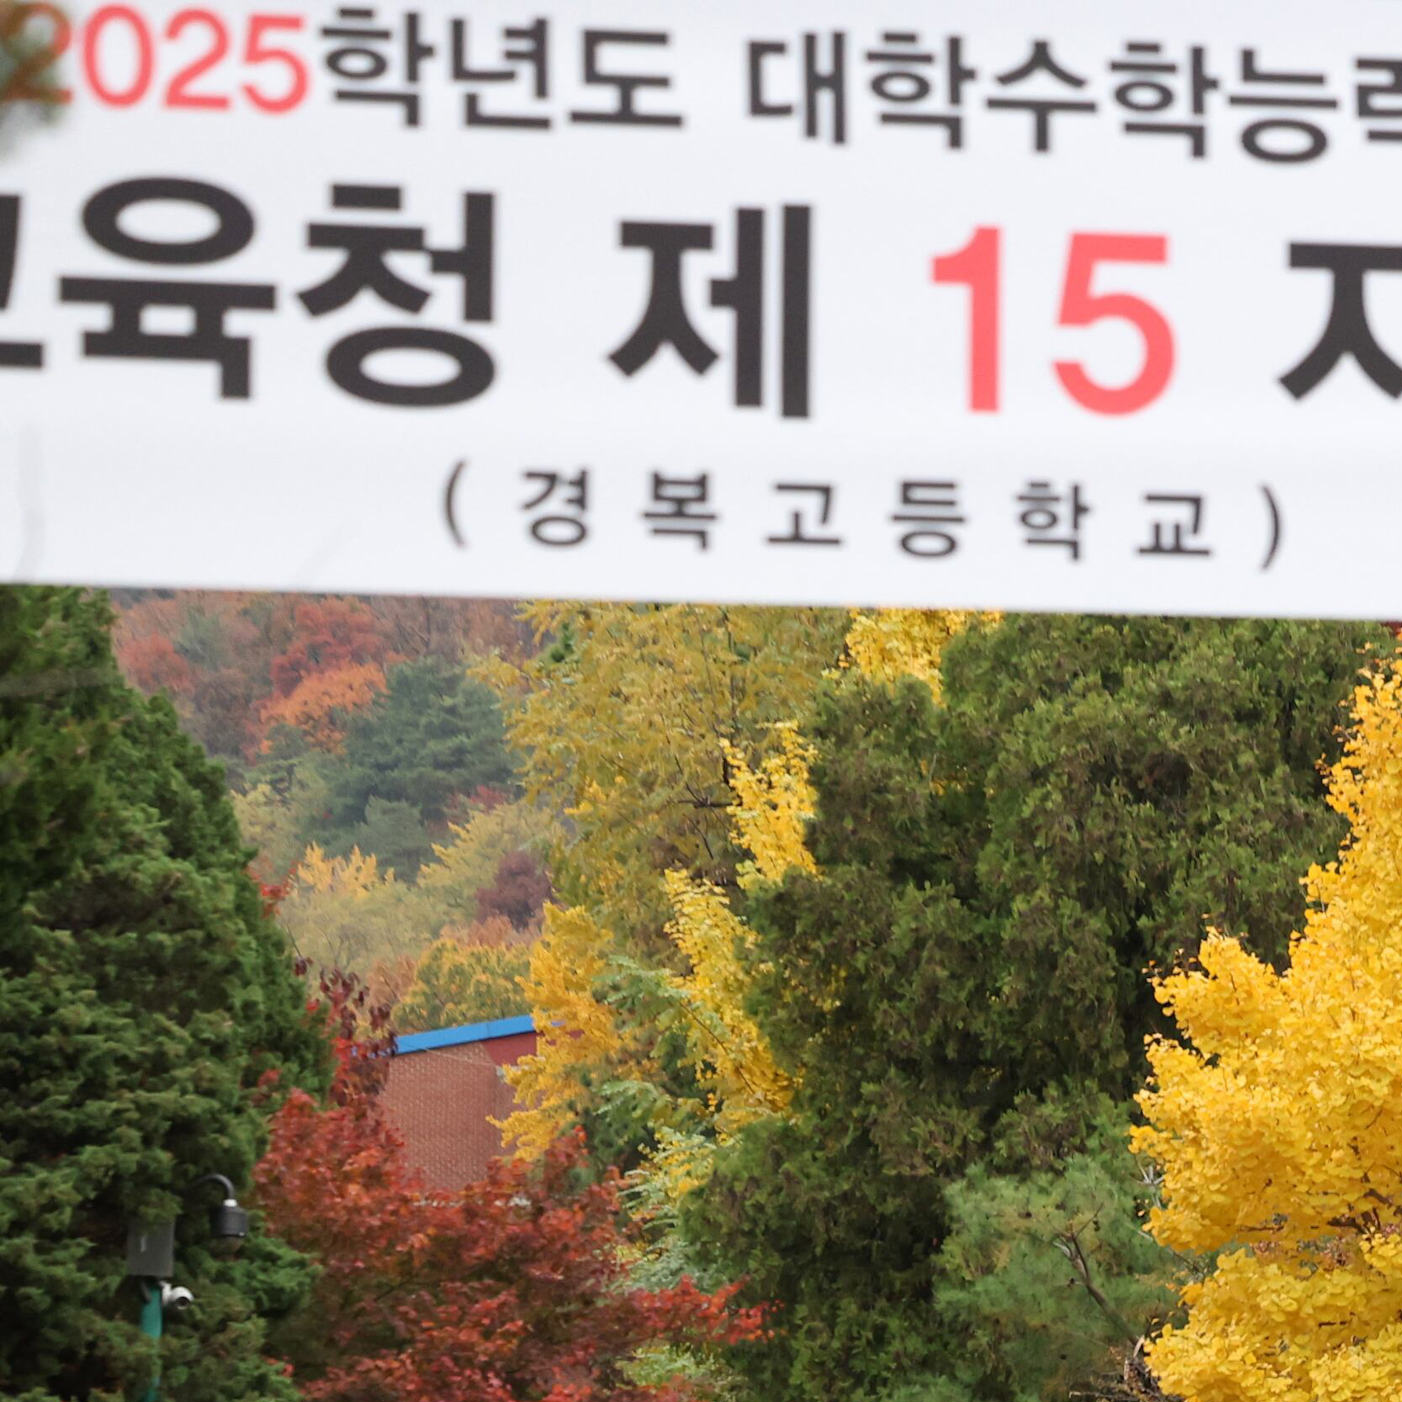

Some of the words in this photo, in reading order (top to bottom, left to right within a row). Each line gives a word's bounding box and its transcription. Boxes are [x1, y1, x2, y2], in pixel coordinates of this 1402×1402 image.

[0, 3, 683, 131] 2025학년도
[0, 176, 497, 409] 육청
[608, 204, 812, 419] 제
[930, 225, 1177, 417] 15
